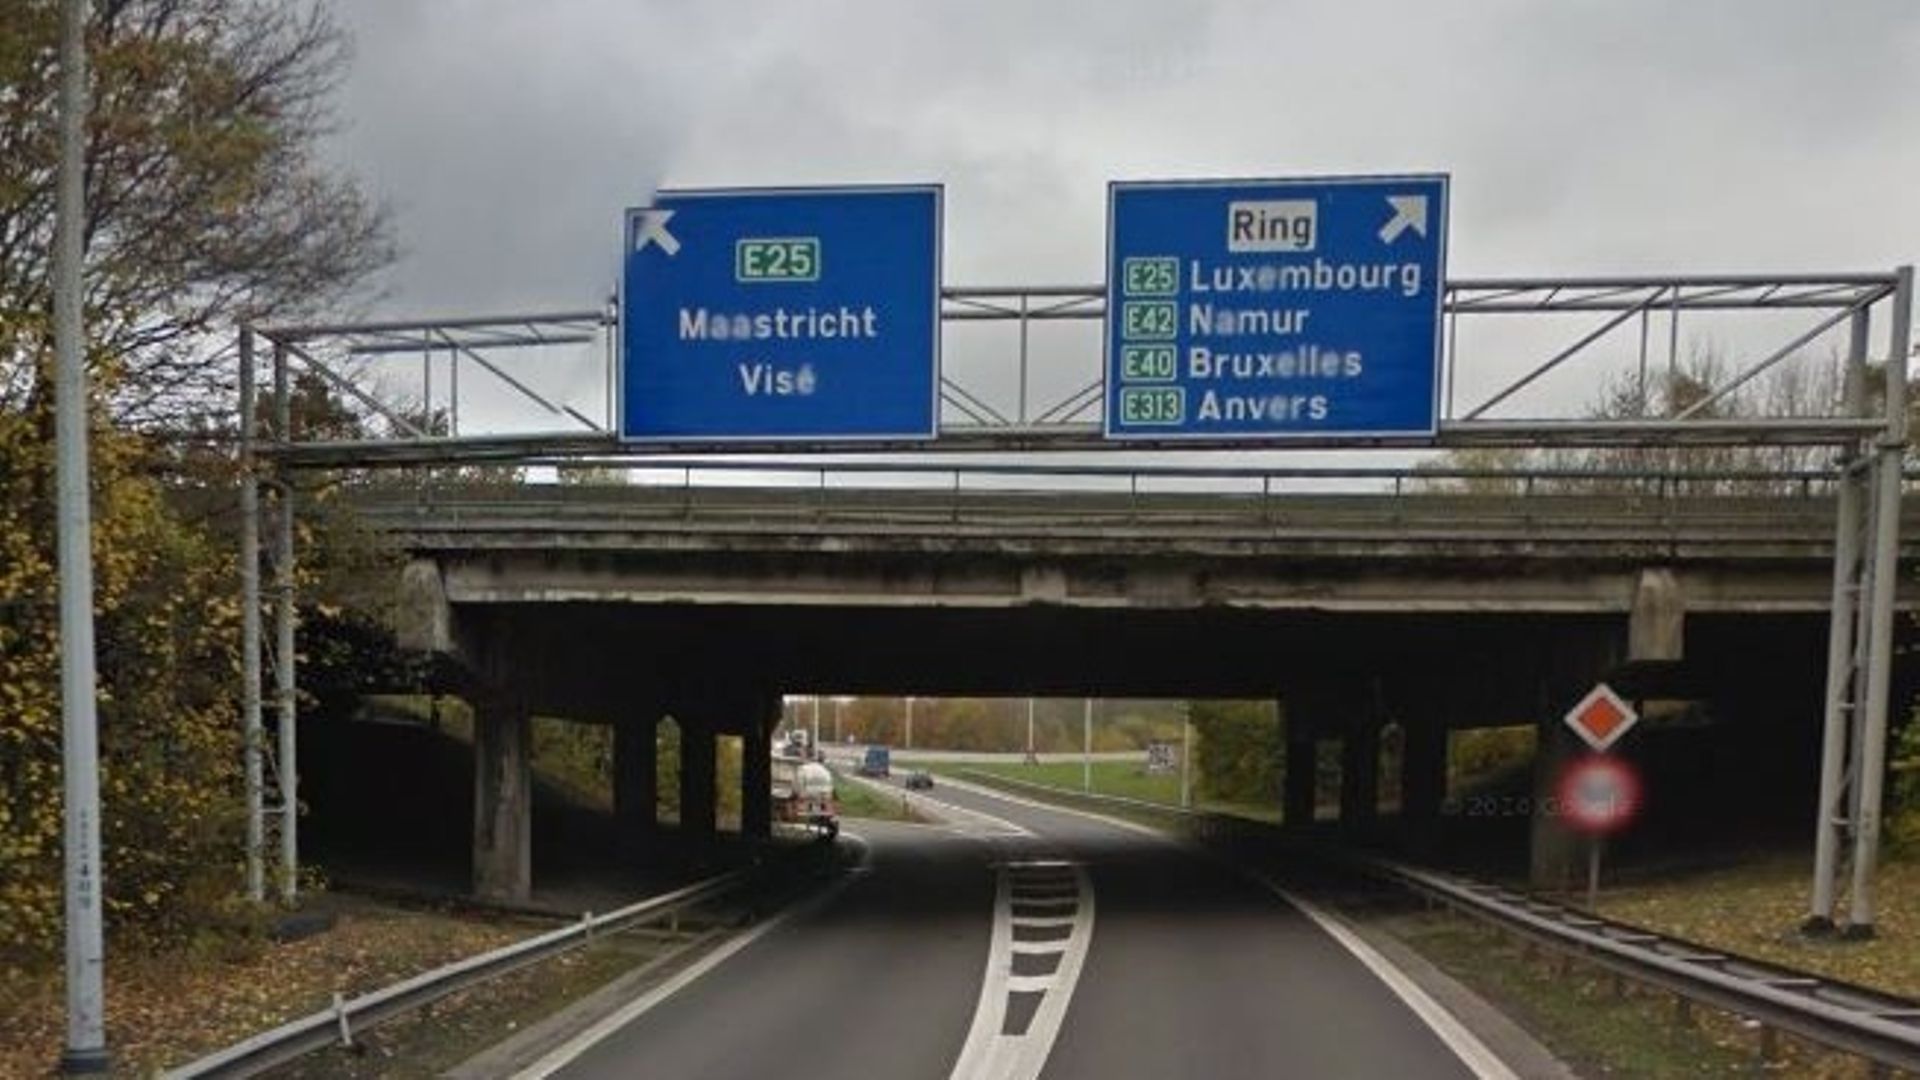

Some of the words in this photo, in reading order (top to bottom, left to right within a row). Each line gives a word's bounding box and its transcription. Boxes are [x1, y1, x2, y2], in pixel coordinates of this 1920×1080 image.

[1234, 210, 1312, 247] Ring
[743, 244, 811, 277] E25
[1127, 263, 1175, 292] E25
[1192, 259, 1420, 296] Luxembourg
[680, 307, 877, 339] Maastricht
[1127, 306, 1174, 334] E42
[1190, 305, 1309, 335] Namur
[1125, 350, 1173, 376] E40
[1190, 347, 1362, 377] Bruxelles
[740, 364, 815, 395] Visé
[1124, 393, 1178, 419] E313
[1198, 391, 1327, 420] Anvers
